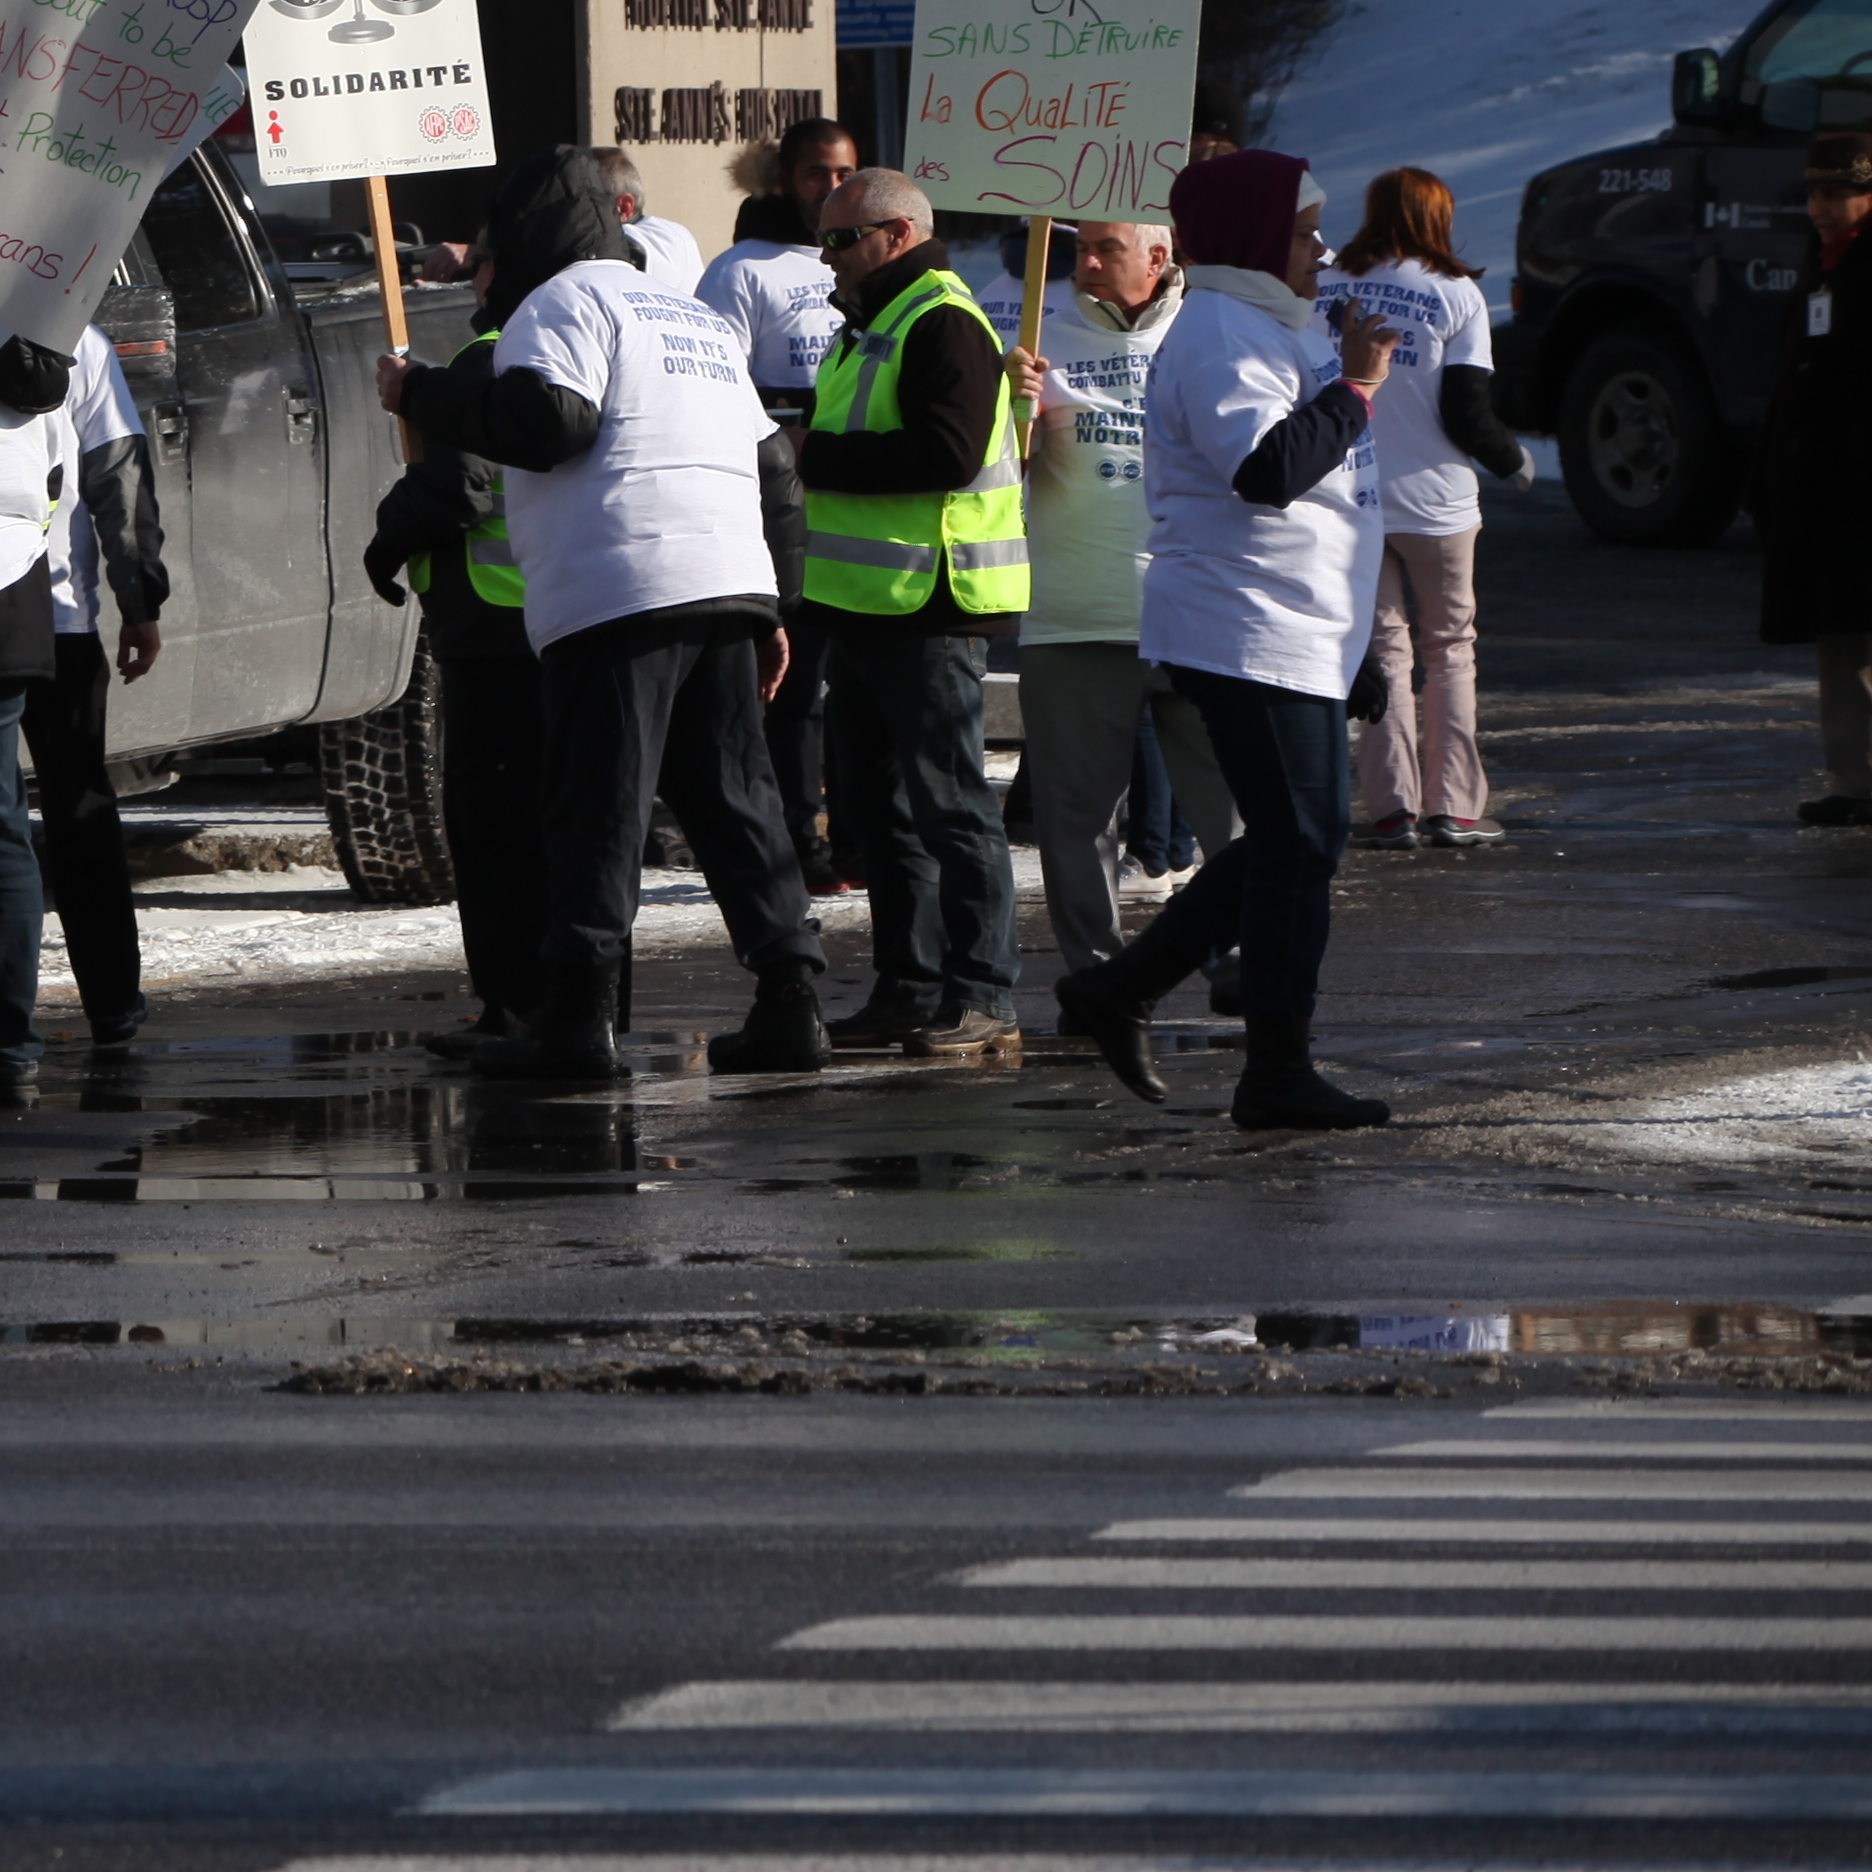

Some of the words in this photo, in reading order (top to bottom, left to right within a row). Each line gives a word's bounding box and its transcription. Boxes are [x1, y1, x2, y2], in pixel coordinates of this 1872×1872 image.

[118, 2, 149, 44] to
[152, 22, 193, 69] be
[922, 22, 1031, 58] SANS
[264, 59, 472, 102] SOLIDARITÉ
[615, 86, 660, 144] STE
[17, 111, 142, 201] Protection
[914, 156, 950, 182] des
[1598, 169, 1672, 193] 221-548
[622, 291, 653, 305] OUR
[1354, 282, 1440, 311] VETERANS
[634, 308, 685, 324] FOUGHT
[686, 315, 711, 329] FOR
[714, 320, 730, 335] US
[1379, 301, 1409, 317] FOR
[1416, 311, 1436, 326] US
[661, 333, 698, 355] NOW
[702, 341, 728, 361] IT'S
[663, 356, 698, 376] OUR
[700, 362, 738, 385] TURN
[1067, 361, 1096, 375] LES
[1068, 373, 1141, 389] COMBATTU
